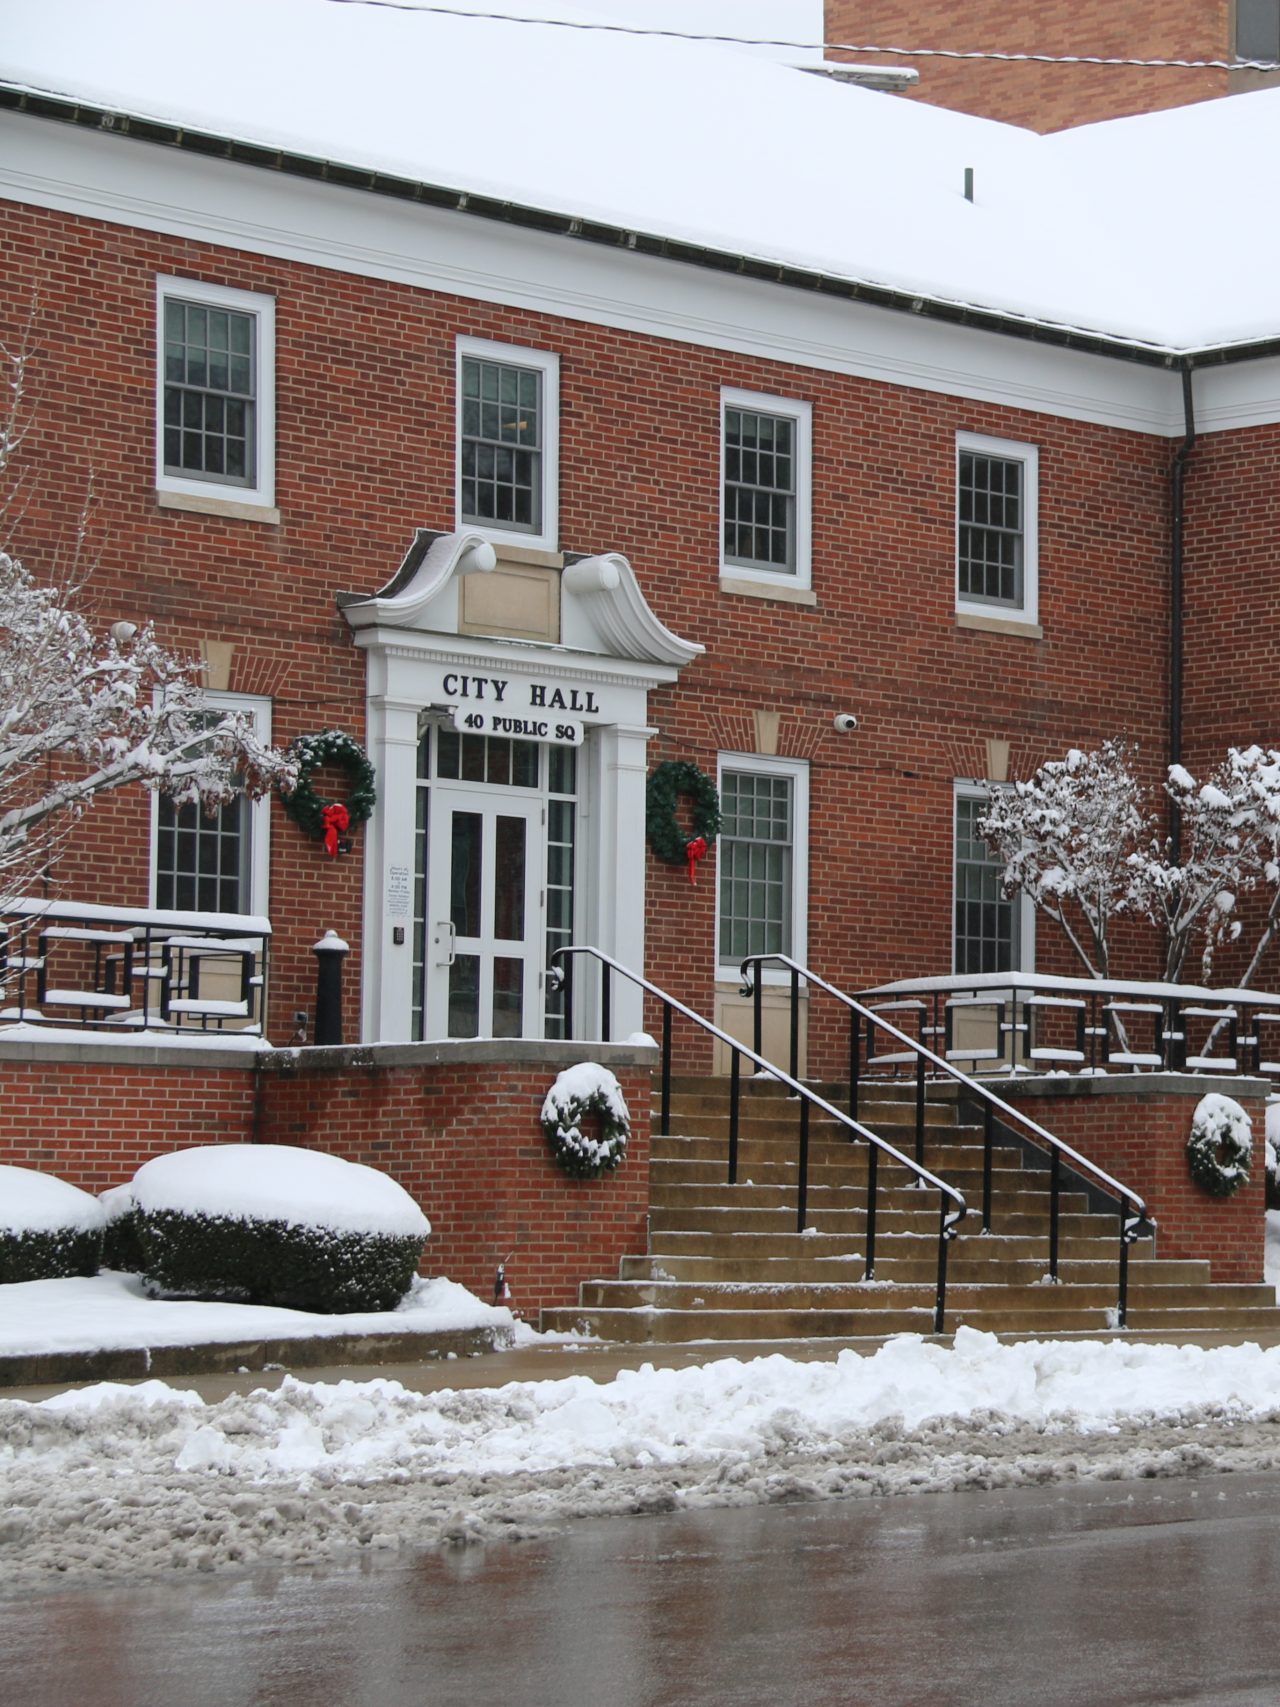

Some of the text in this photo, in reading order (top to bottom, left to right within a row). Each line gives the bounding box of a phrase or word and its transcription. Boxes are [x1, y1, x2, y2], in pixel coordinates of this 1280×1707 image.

[443, 673, 600, 713] CITY HALL
[464, 713, 576, 741] 40 PUBLIC SQ
